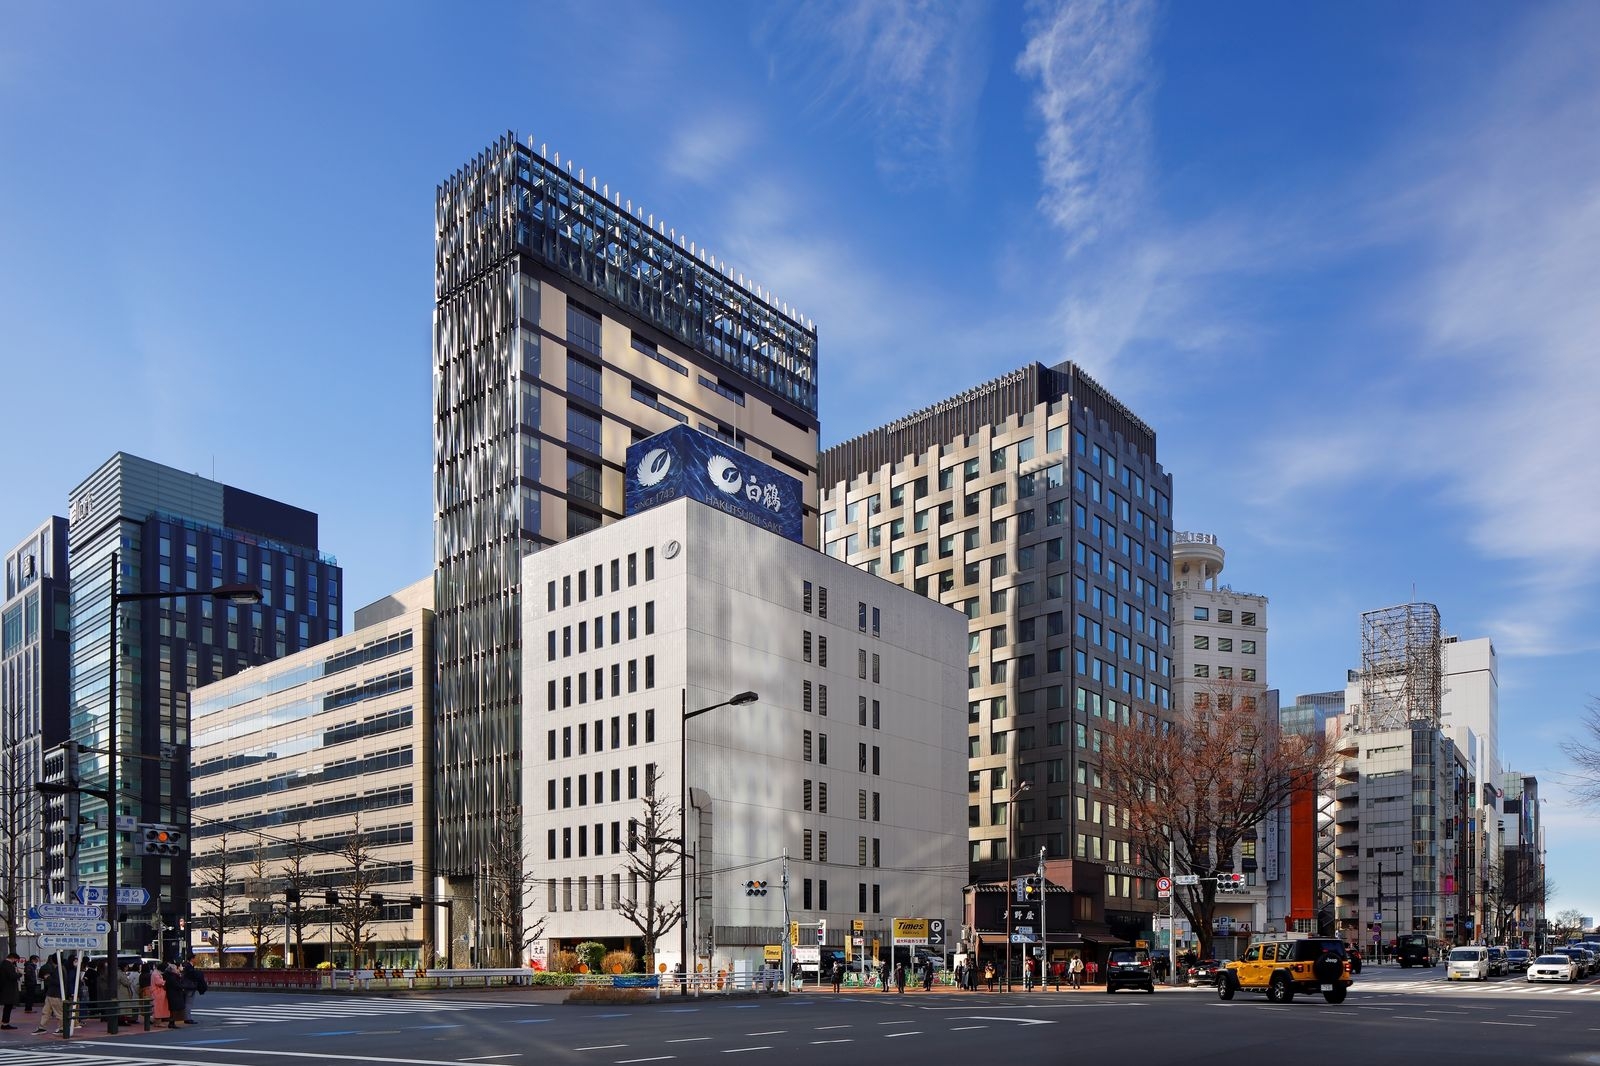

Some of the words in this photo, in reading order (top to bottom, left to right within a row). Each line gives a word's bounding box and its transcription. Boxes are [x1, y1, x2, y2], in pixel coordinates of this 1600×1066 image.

[887, 411, 931, 435] Millennium
[934, 399, 963, 416] Mitsui
[964, 383, 997, 403] Garden
[999, 370, 1025, 389] Hotel
[634, 497, 654, 510] SINCE
[656, 487, 675, 502] 1743
[745, 475, 781, 513] 白鶴
[705, 494, 760, 525] HAKUTSURU
[762, 518, 784, 534] SAKE
[898, 921, 924, 930] Times
